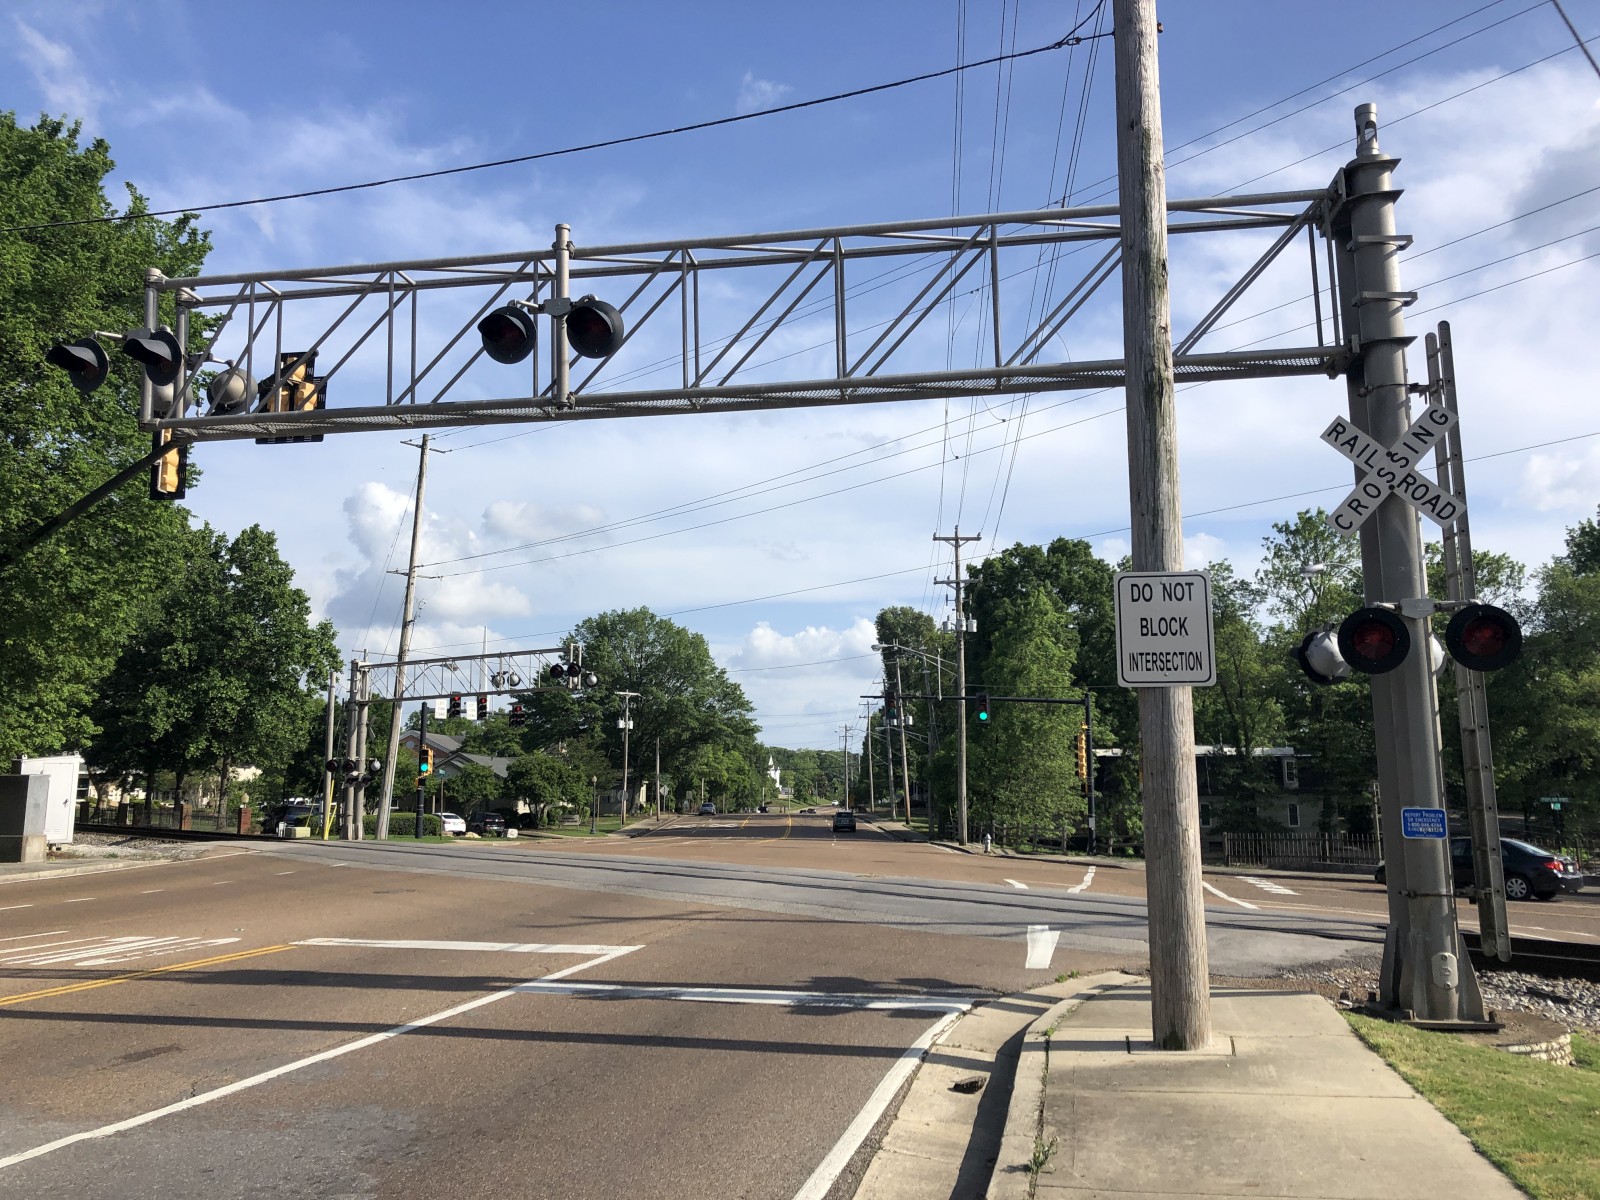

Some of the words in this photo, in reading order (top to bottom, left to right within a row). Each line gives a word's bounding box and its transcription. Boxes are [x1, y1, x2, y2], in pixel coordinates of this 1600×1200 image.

[1334, 408, 1449, 531] CROSSING
[1131, 583, 1153, 602] DO
[1162, 582, 1194, 602] NOT
[1140, 616, 1189, 637] BLOCK
[1129, 651, 1203, 672] INTERSECTION
